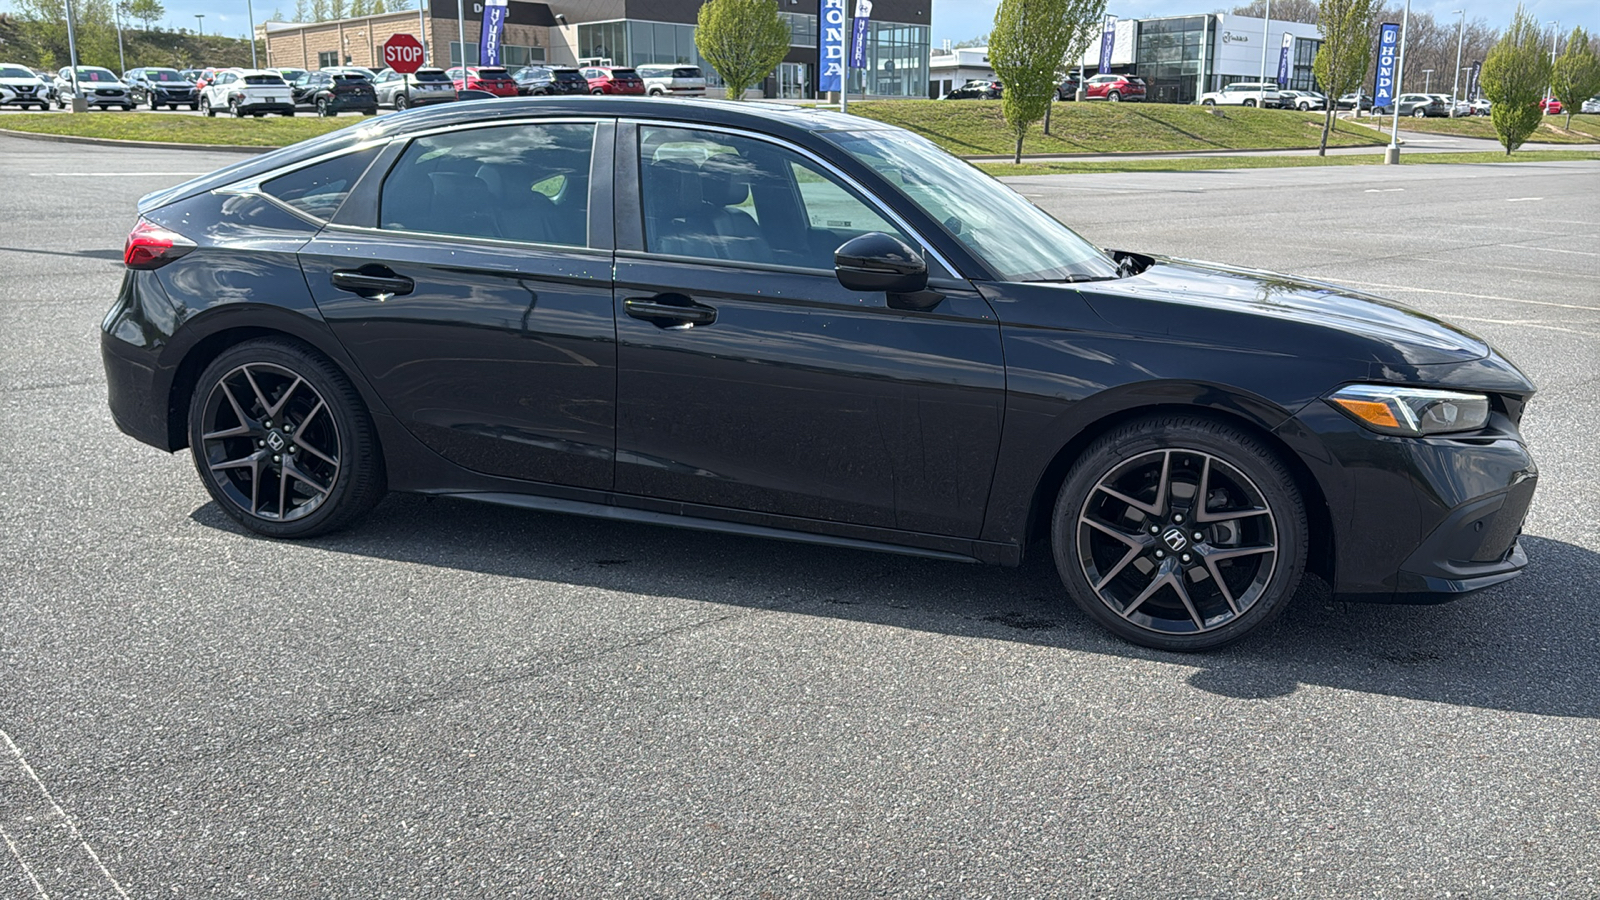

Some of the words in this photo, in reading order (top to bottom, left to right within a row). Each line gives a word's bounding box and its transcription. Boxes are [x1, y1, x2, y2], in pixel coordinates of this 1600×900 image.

[386, 46, 422, 62] STOP
[487, 9, 500, 65] HYUNDAI
[824, 0, 842, 76] HONDA
[855, 19, 865, 67] HYUNDAI
[1377, 46, 1395, 98] HONDA
